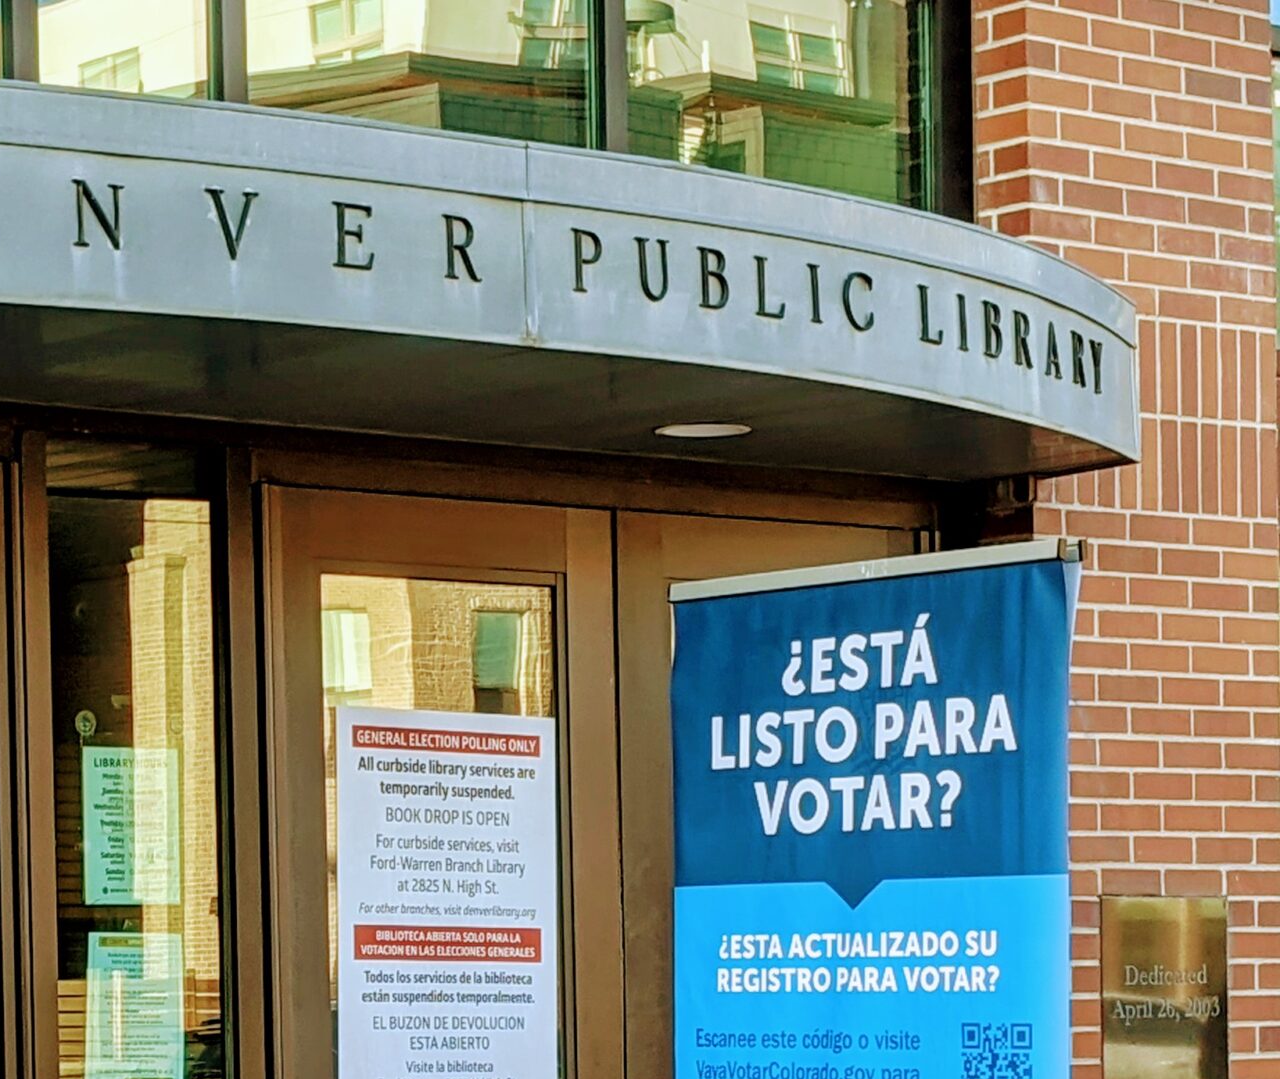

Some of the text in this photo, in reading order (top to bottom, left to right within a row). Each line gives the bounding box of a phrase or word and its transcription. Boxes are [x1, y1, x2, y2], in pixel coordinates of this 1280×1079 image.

[571, 227, 876, 332] PUBLIC
[919, 283, 1104, 395] LIBRARY
[782, 613, 938, 696] ¿ESTÁ
[357, 730, 536, 753] GENERAL ELECTION POLLING ONLY
[711, 694, 1018, 770] LISTO PARA
[94, 757, 134, 768] LIBRARY
[379, 781, 515, 801] temporarily suspended.
[754, 770, 962, 836] VOTAR?
[385, 806, 510, 826] BOOK DROP IS OPEN
[397, 878, 499, 898] at 2825 N. High St.
[719, 931, 999, 960] ¿ESTA ACTUALIZADO SU
[717, 966, 1000, 993] REGISTRO PARA VOTAR?
[1125, 964, 1208, 986] Dedicated
[1113, 996, 1220, 1026] April 26, 2003
[440, 1036, 490, 1050] ABIERTO
[695, 1028, 920, 1053] Escanee este código o visite
[405, 1060, 494, 1073] Visite la biblioteca
